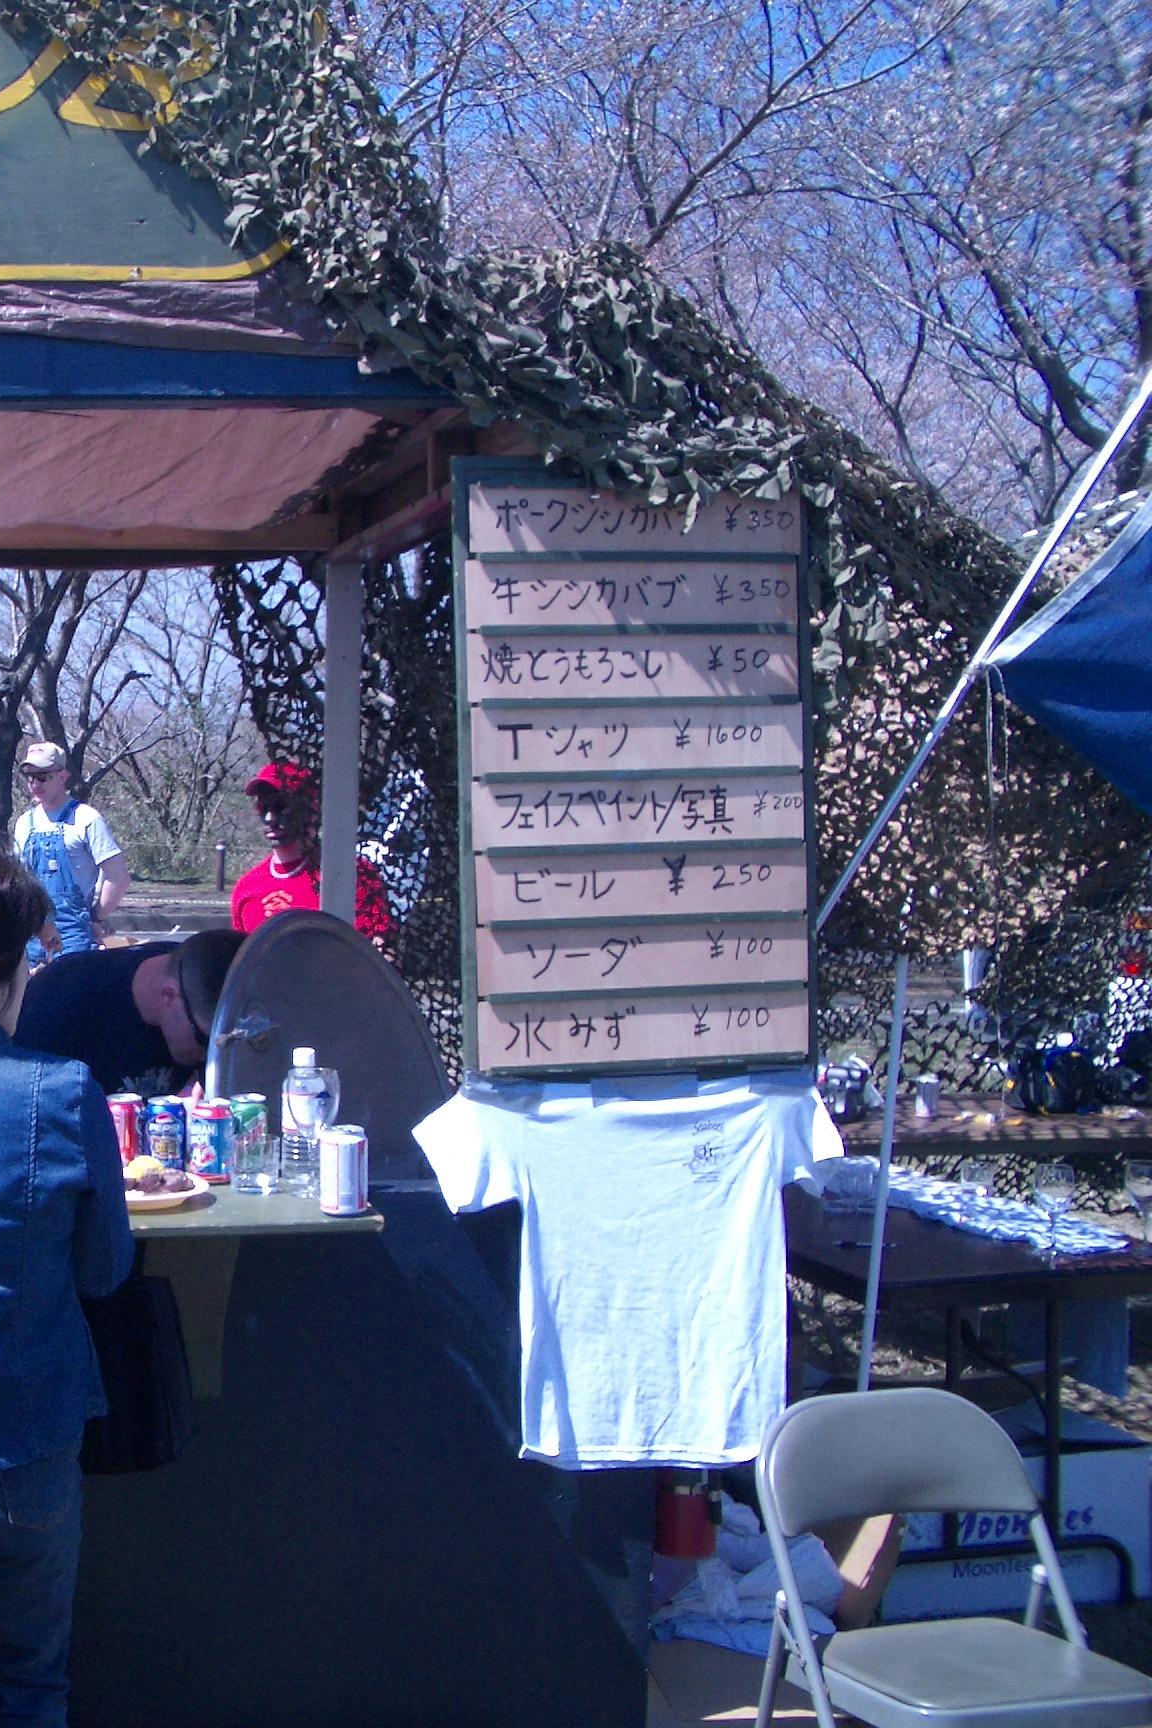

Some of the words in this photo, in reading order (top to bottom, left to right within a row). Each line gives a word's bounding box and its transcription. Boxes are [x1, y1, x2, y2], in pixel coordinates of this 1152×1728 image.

[514, 867, 616, 903] ビール
[526, 936, 645, 979] ソーダ
